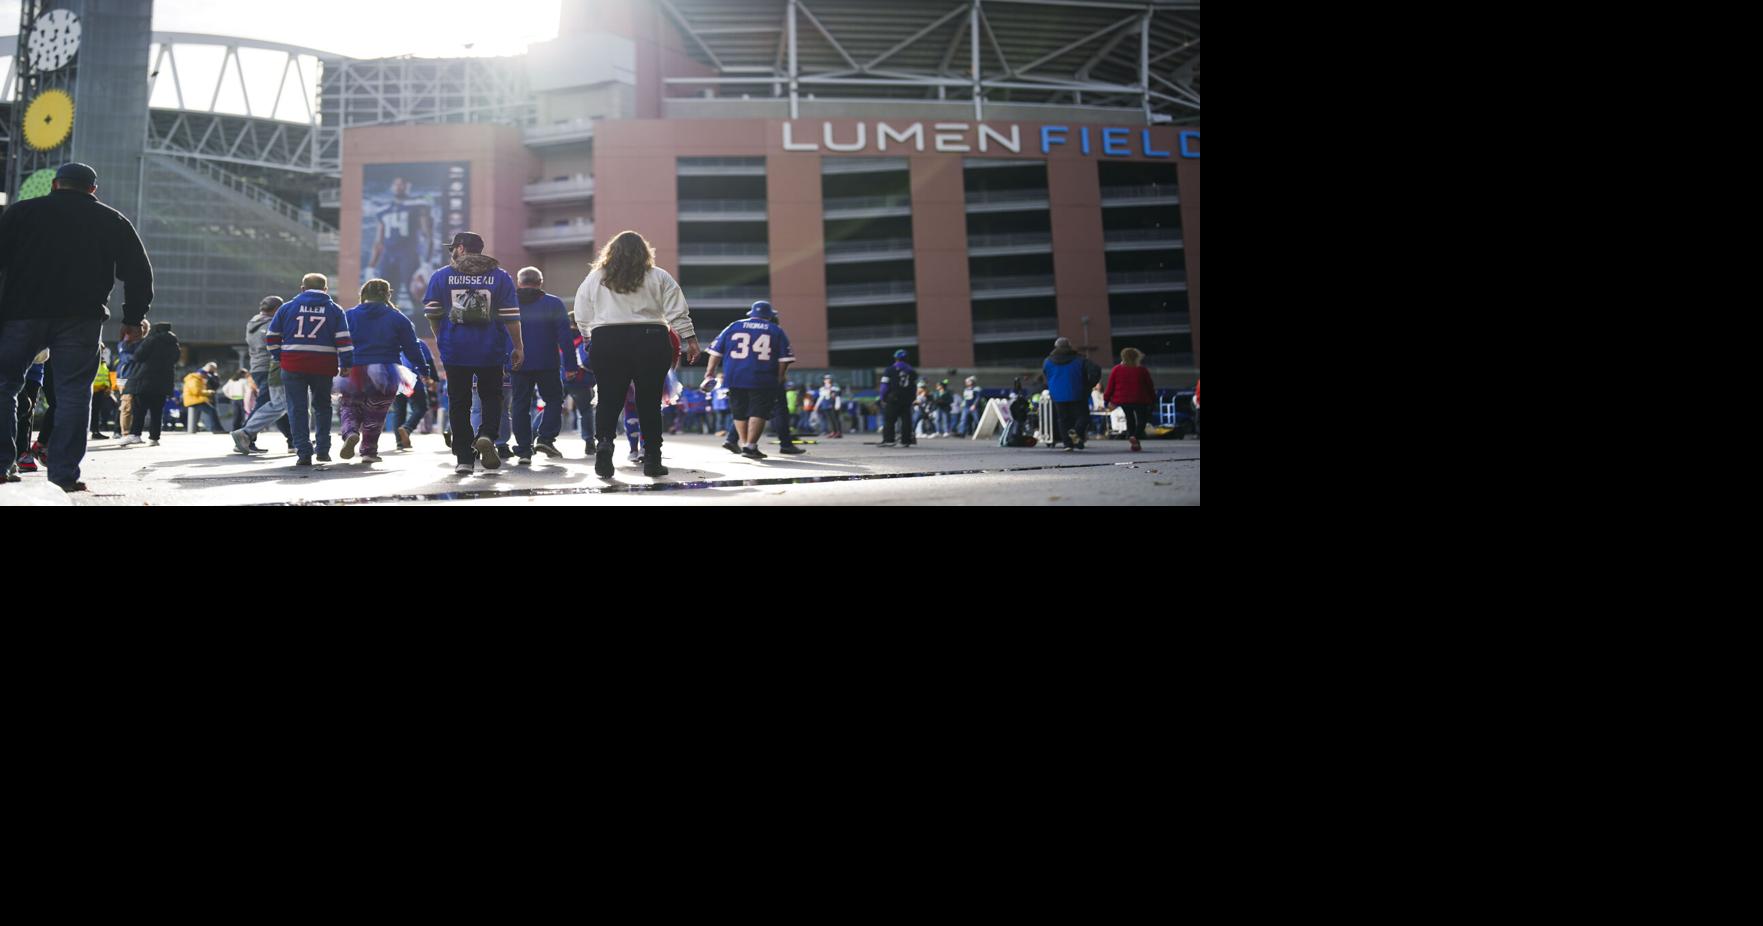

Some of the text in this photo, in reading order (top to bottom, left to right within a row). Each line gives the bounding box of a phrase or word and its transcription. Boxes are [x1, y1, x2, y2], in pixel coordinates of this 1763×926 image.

[782, 121, 1021, 153] LUMEN
[448, 275, 495, 285] ROUSSEAU
[299, 305, 326, 313] ALLEN
[293, 315, 327, 338] 17
[743, 322, 769, 330] THOMAS
[730, 332, 772, 360] 34
